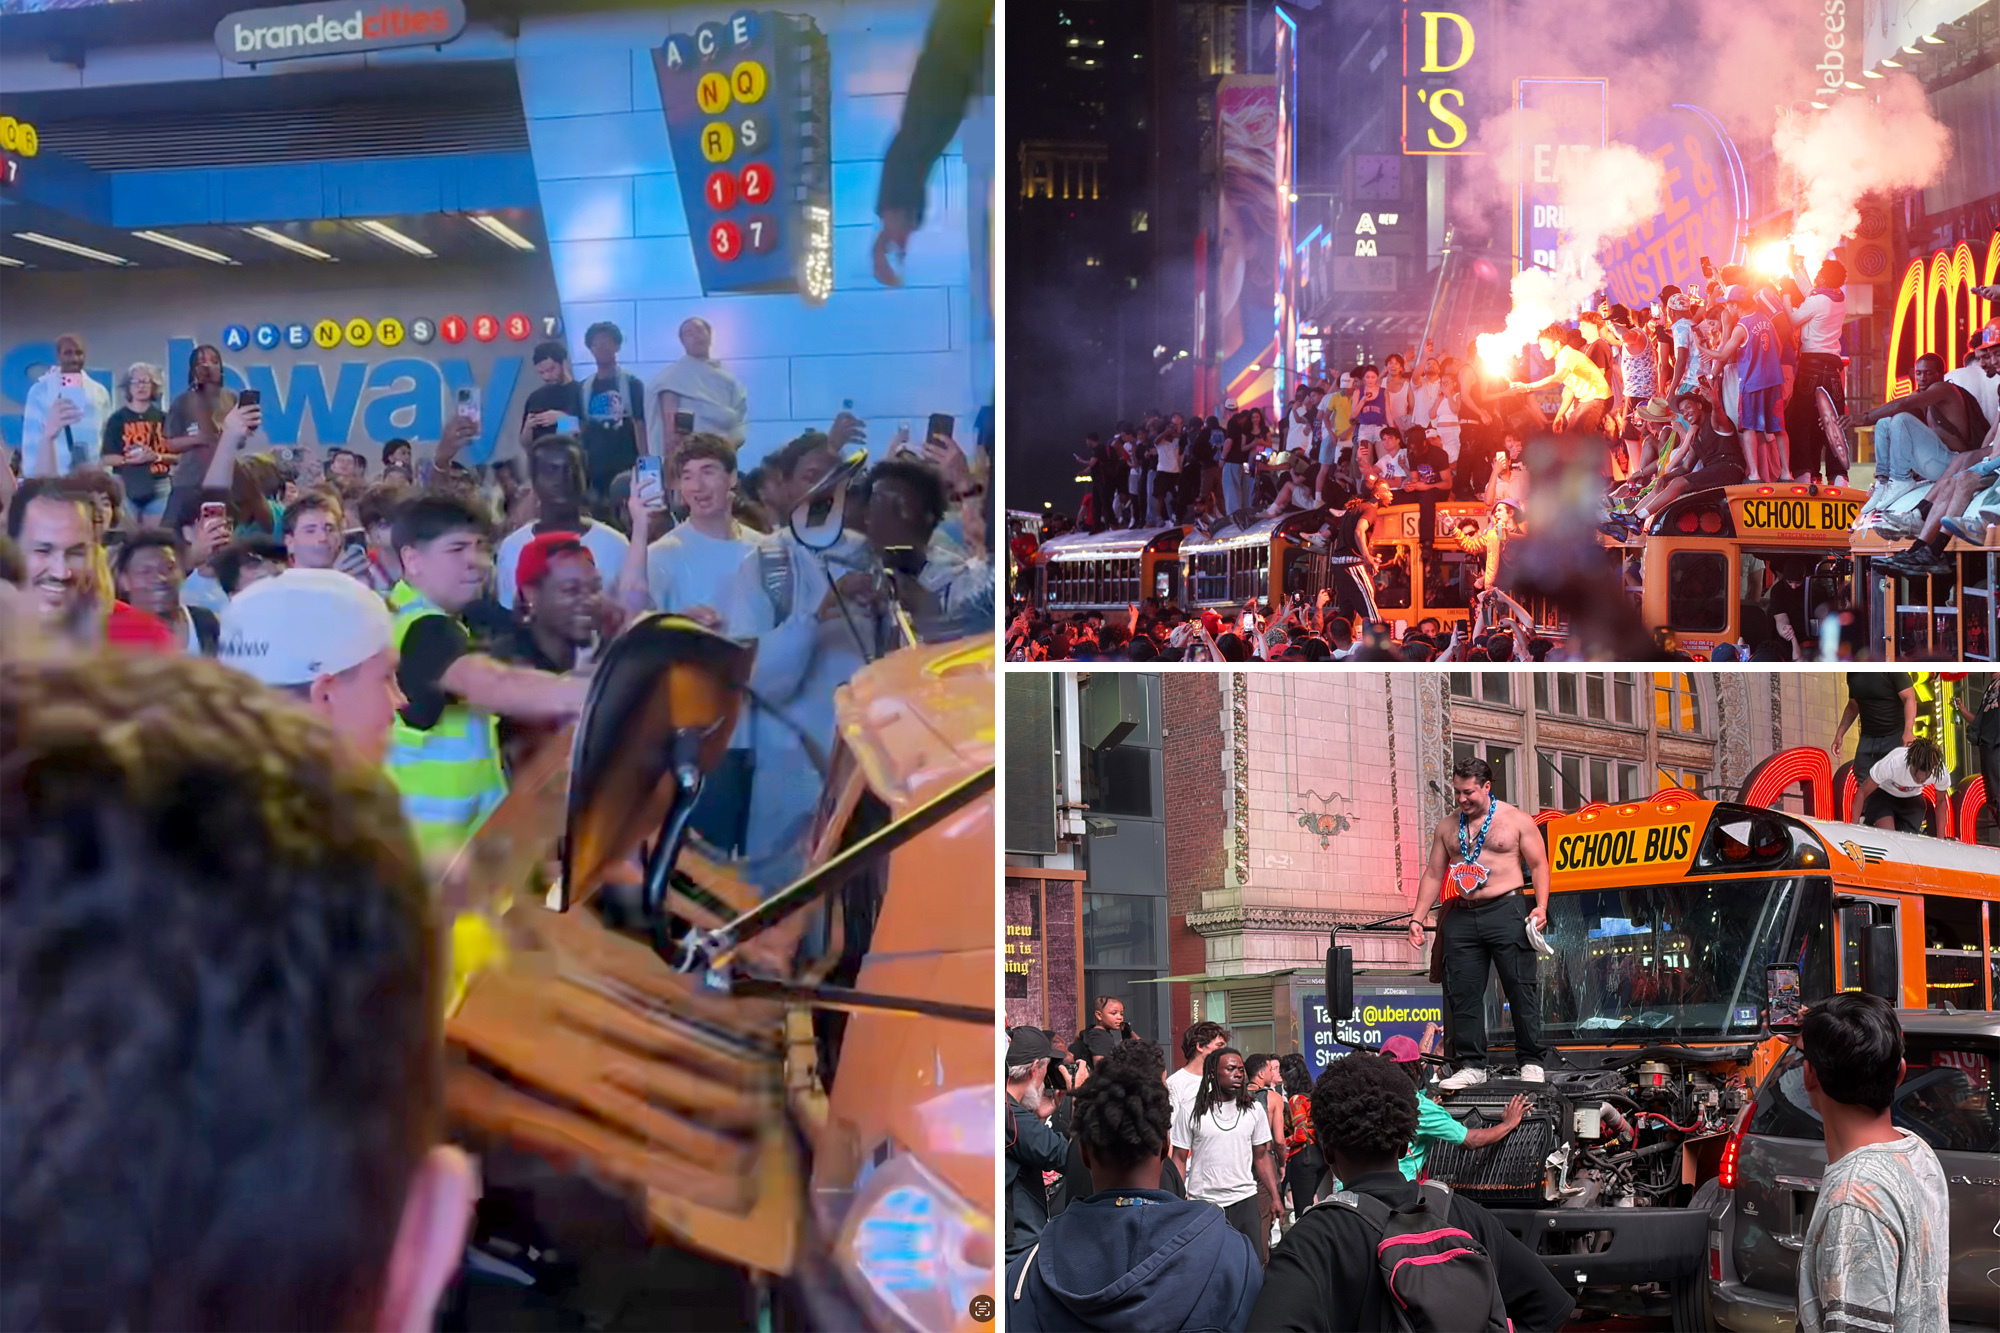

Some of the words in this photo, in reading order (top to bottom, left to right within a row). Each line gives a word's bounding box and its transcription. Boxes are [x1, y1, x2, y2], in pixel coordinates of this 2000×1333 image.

[234, 5, 449, 52] brandedcities
[667, 41, 682, 68] A
[698, 29, 715, 55] C
[732, 16, 749, 44] E
[703, 80, 718, 107] N
[737, 70, 754, 95] Q
[708, 130, 722, 155] R
[740, 120, 757, 146] S
[8, 160, 17, 182] 7
[713, 179, 722, 203] 1
[746, 170, 760, 196] 2
[716, 228, 729, 253] 3
[750, 222, 762, 247] 7
[1607, 196, 1721, 307] BUSTER'S
[228, 329, 242, 346] A
[257, 327, 272, 344] C
[289, 326, 302, 342] E
[320, 326, 332, 341] N
[352, 324, 366, 341] Q
[384, 324, 396, 341] R
[414, 322, 427, 340] S
[448, 322, 457, 338] 1
[479, 320, 491, 336] 2
[511, 318, 523, 335] 3
[543, 317, 556, 334] 7
[1761, 333, 1770, 351] 3
[1743, 500, 1817, 530] SCHOOL
[1821, 502, 1859, 530] BUS
[1556, 830, 1638, 871] SCHOOL
[1644, 824, 1691, 862] BUS
[1007, 925, 1032, 937] new
[1019, 941, 1032, 955] is
[1363, 1005, 1442, 1026] @uber.com
[1363, 1030, 1382, 1043] on
